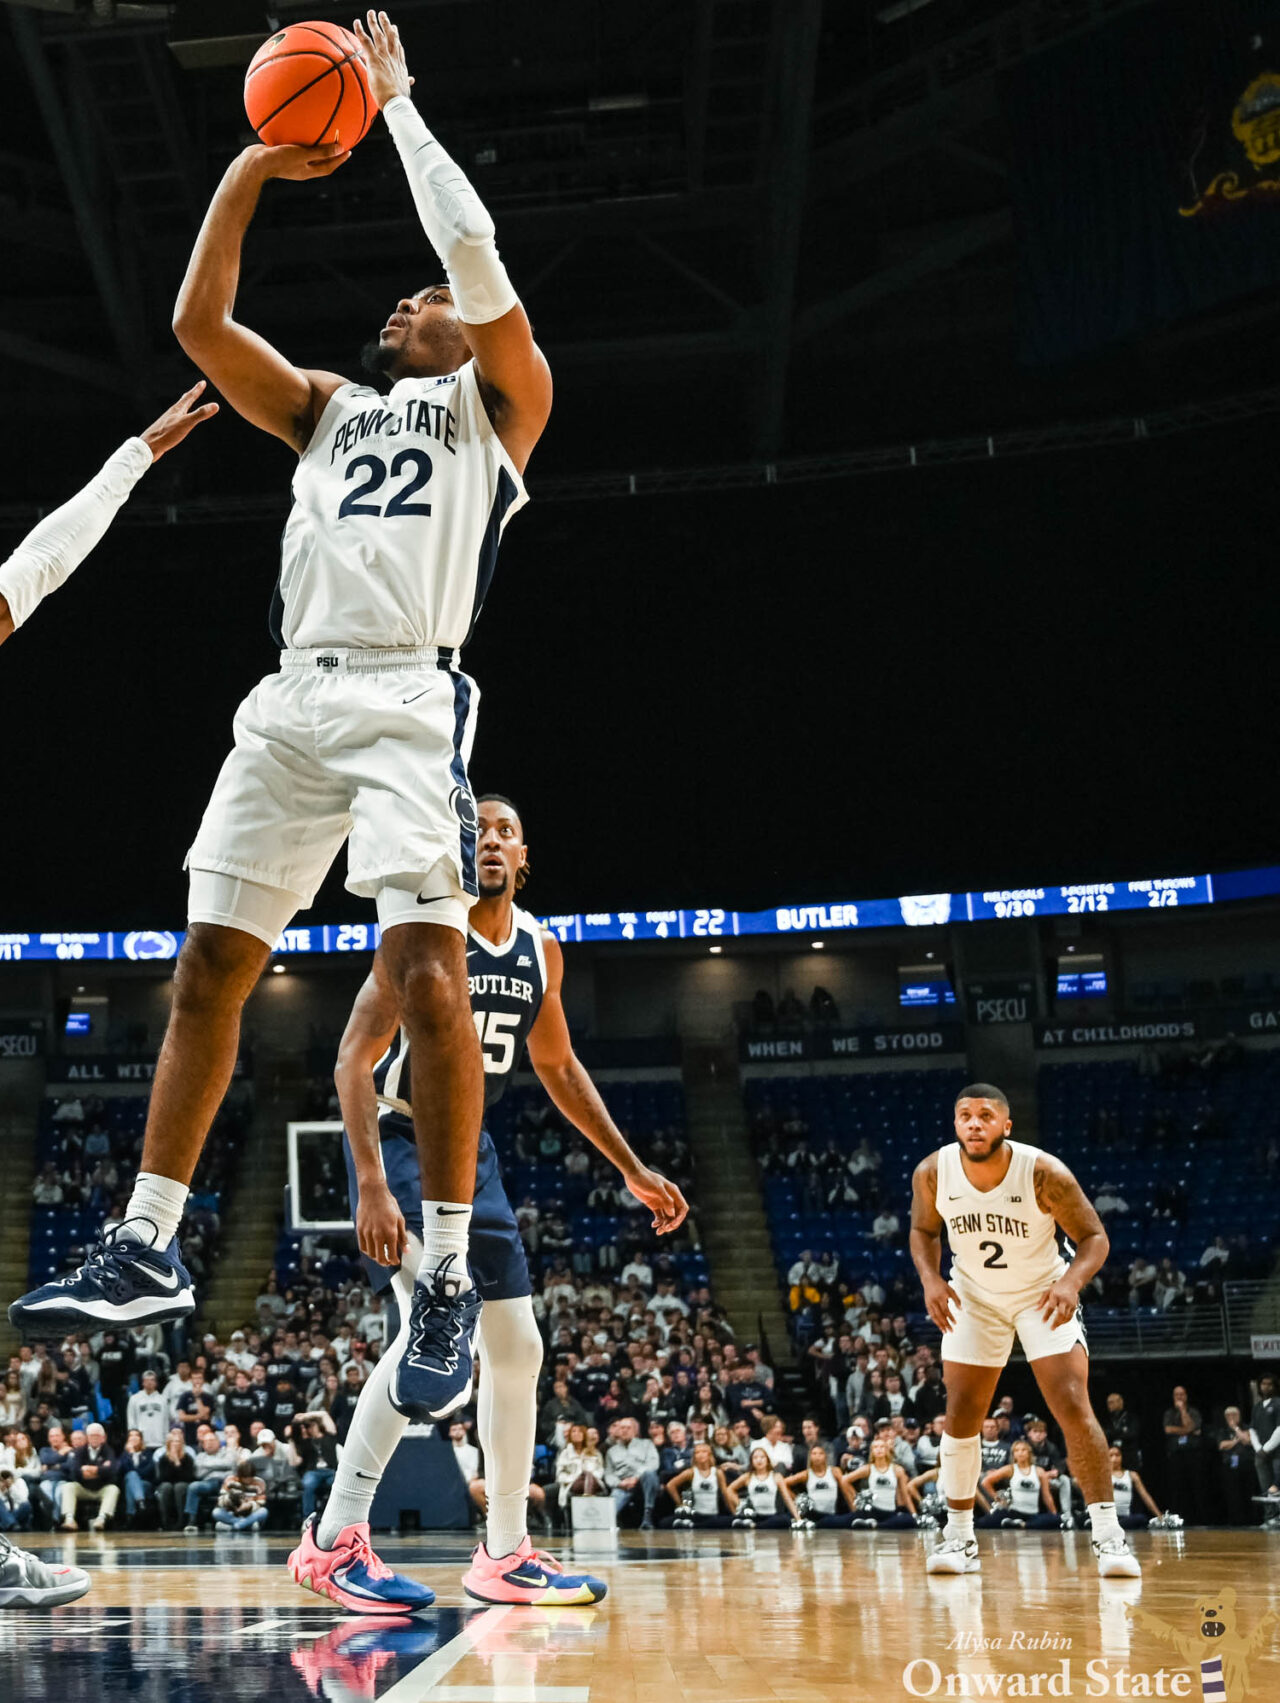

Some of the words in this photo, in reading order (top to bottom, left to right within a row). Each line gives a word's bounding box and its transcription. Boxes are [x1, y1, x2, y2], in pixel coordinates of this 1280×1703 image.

[331, 411, 394, 466] PENN
[338, 448, 433, 520] 22
[316, 656, 339, 668] PSU
[993, 899, 1036, 919] 9/30
[1067, 894, 1109, 913] 2/12
[1147, 889, 1179, 908] 2/2
[692, 909, 726, 936] 22
[776, 904, 859, 931] BUTLER
[271, 929, 311, 952] ATE
[336, 924, 368, 951] 29
[467, 974, 534, 1003] BUTLER
[976, 999, 1026, 1022] PSECU
[1249, 1011, 1280, 1029] GA
[473, 1010, 521, 1074] 15
[748, 1040, 803, 1057] WHEN
[832, 1036, 859, 1053] WE
[873, 1032, 943, 1050] STOOD
[1042, 1029, 1065, 1044] AT
[67, 1064, 104, 1079] ALL
[117, 1063, 155, 1078] WIT
[950, 1213, 982, 1234] PENN
[986, 1213, 1030, 1239] STATE
[979, 1240, 1008, 1269] 2
